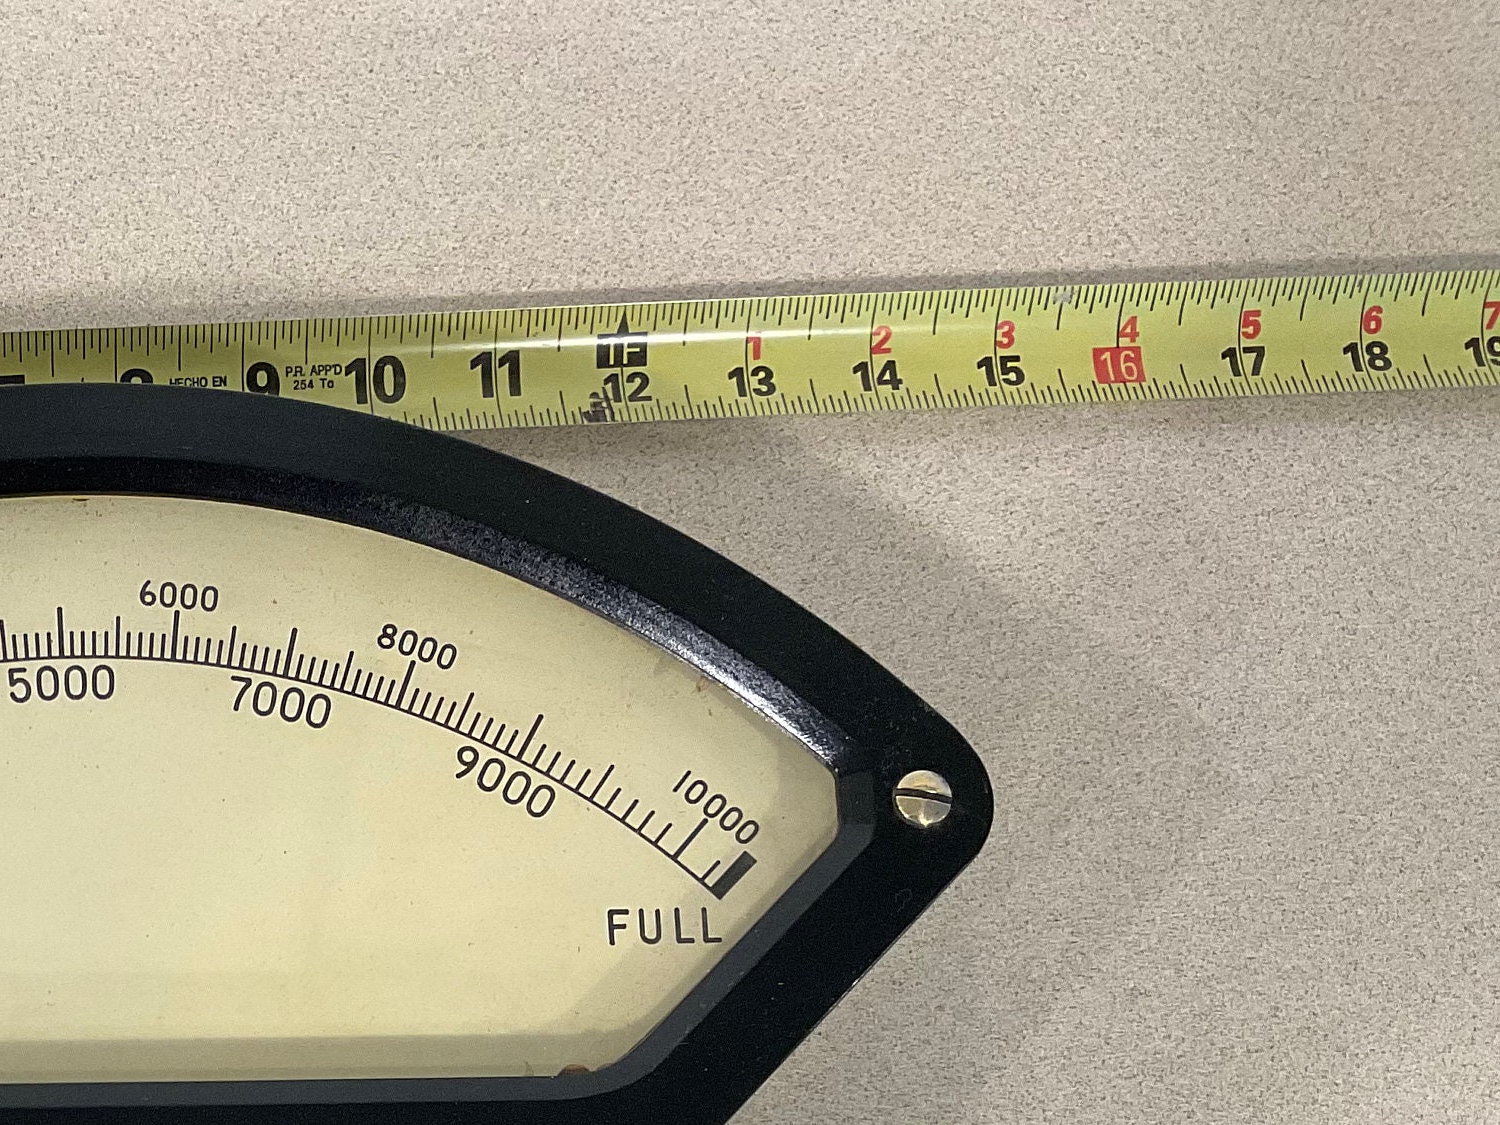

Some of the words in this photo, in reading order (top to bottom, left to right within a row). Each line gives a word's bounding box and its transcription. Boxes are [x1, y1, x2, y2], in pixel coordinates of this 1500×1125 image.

[997, 320, 1016, 349] 3
[1119, 316, 1140, 343] 4
[1240, 310, 1262, 339] 5
[1363, 305, 1384, 335] 6
[747, 335, 762, 361] 1
[871, 325, 892, 355] 2
[1342, 340, 1393, 373] 18
[469, 350, 521, 398] 11
[853, 360, 901, 393] 14
[976, 355, 1026, 387] 15
[1099, 350, 1139, 384] 16
[1220, 346, 1267, 378] 17
[212, 376, 227, 388] EN
[246, 362, 280, 396] 9
[293, 379, 314, 391] 254
[344, 355, 407, 405] 10
[603, 371, 653, 403] 12
[728, 366, 777, 398] 13
[139, 579, 220, 613] 6000
[377, 623, 457, 670] 8000
[7, 664, 116, 704] 5000
[230, 675, 332, 729] 7000
[455, 745, 557, 818] 9000
[672, 770, 760, 845] 10000
[607, 907, 723, 946] FULL
